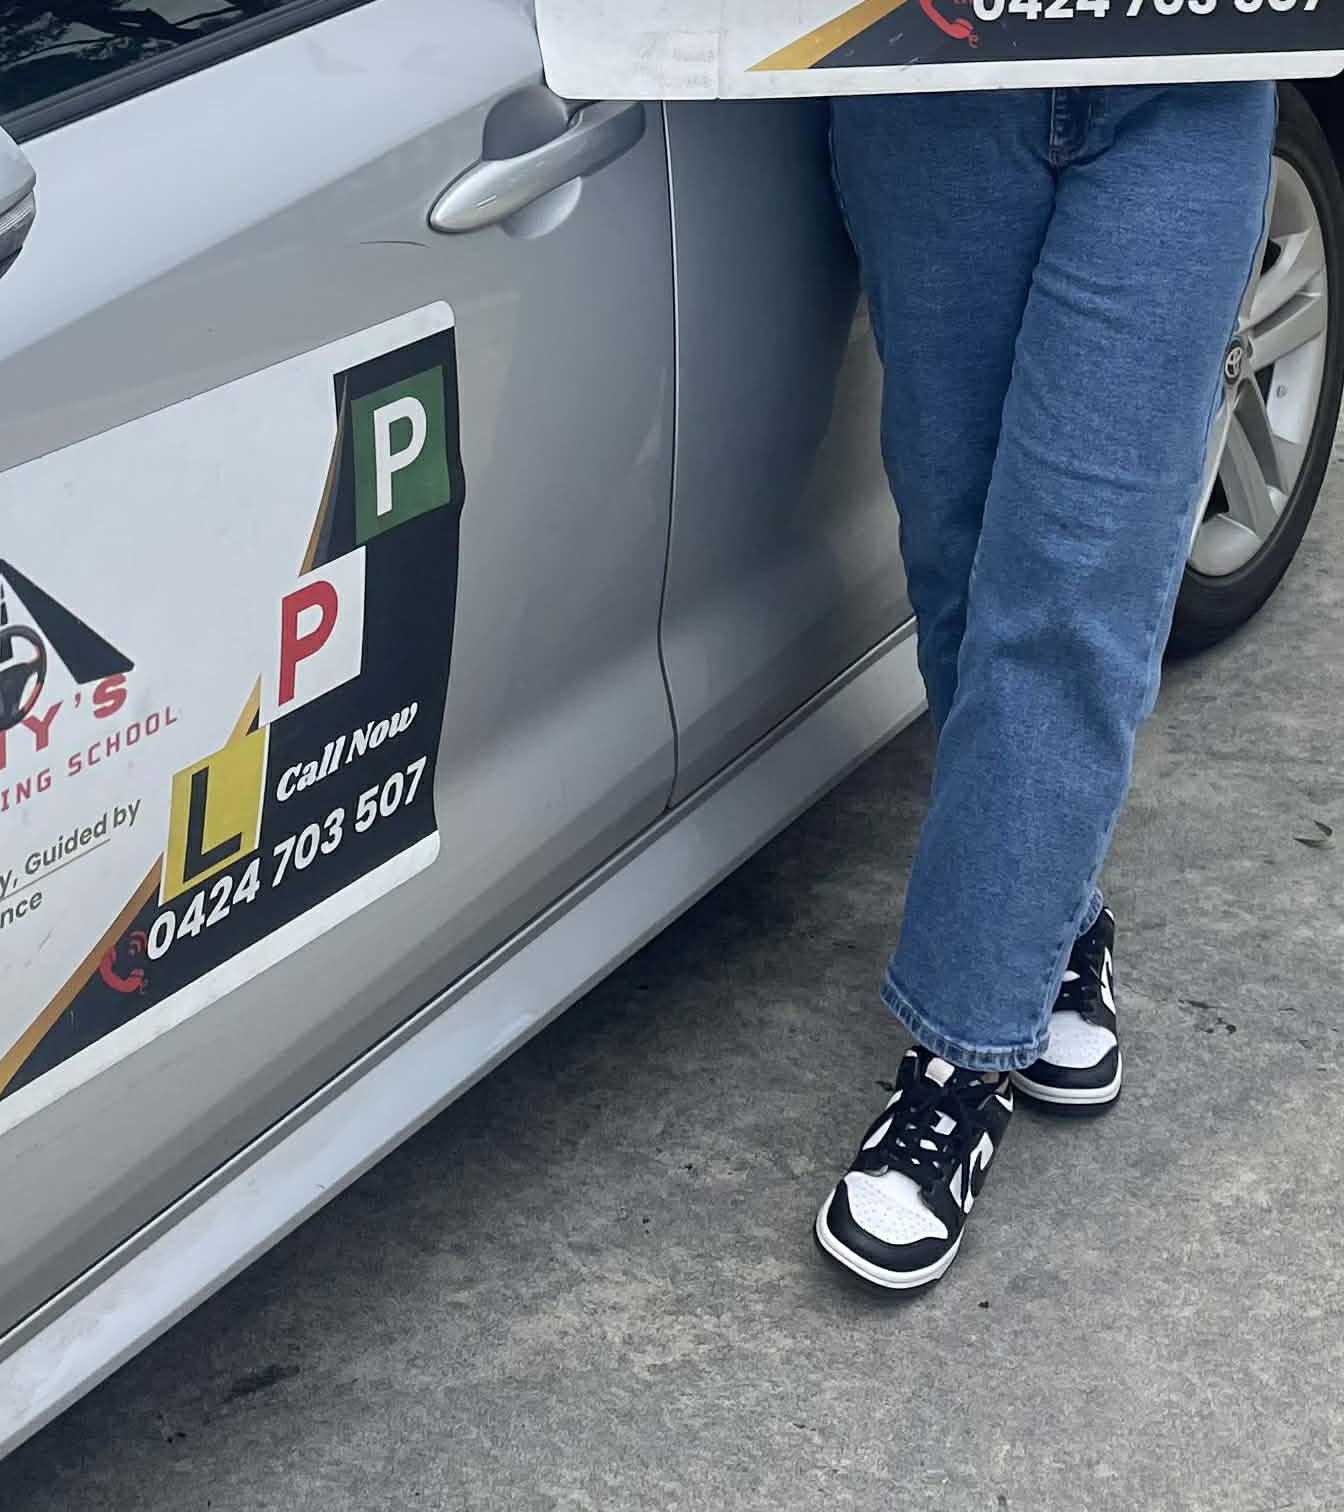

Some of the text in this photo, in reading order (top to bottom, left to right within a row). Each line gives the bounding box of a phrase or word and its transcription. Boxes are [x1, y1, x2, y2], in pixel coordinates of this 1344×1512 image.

[373, 396, 427, 516] P
[278, 580, 338, 707] P
[67, 706, 178, 777] SCHOOL
[276, 702, 418, 803] Call Now
[24, 813, 107, 875] Guided
[112, 799, 143, 829] by
[146, 755, 427, 961] 0424 703 507
[183, 766, 243, 883] L
